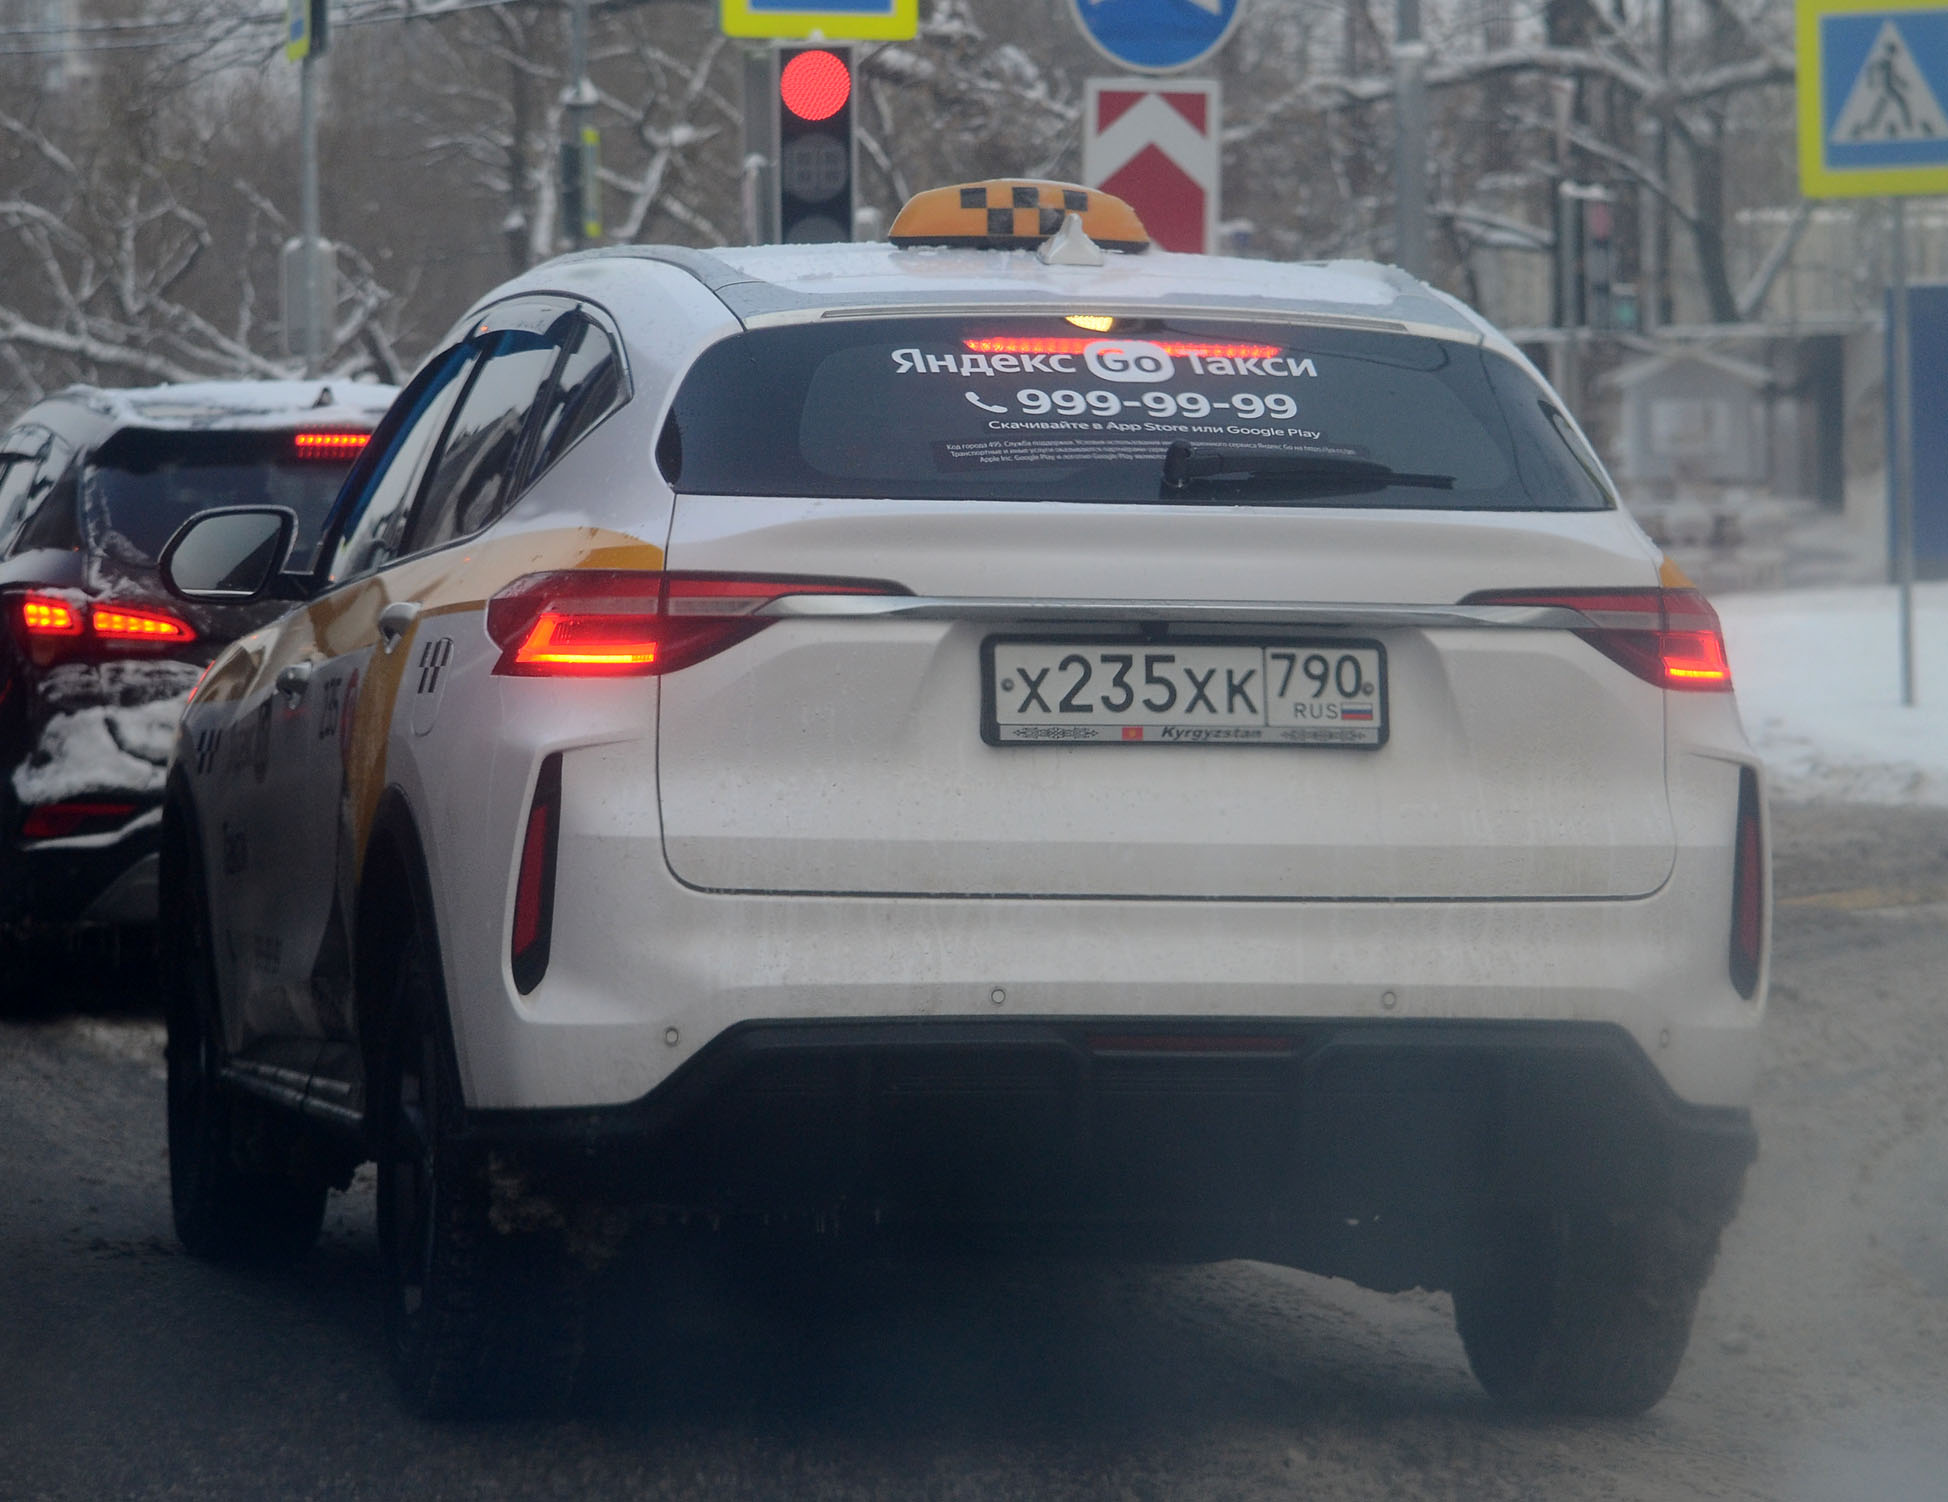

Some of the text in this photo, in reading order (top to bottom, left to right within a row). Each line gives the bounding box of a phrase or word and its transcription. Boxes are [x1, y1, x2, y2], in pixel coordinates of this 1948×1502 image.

[890, 347, 1318, 378] Яндекс Go Такси
[1016, 388, 1299, 419] 999-99-99
[988, 420, 1090, 431] Скачивайте
[1106, 420, 1142, 432] App
[1143, 422, 1190, 433] Store
[1191, 426, 1224, 434] или
[1226, 426, 1286, 437] Google
[1288, 428, 1321, 440] Play
[1269, 652, 1363, 698] 790
[1293, 702, 1339, 719] RUS
[1160, 725, 1263, 741] Kyrgyzstan
